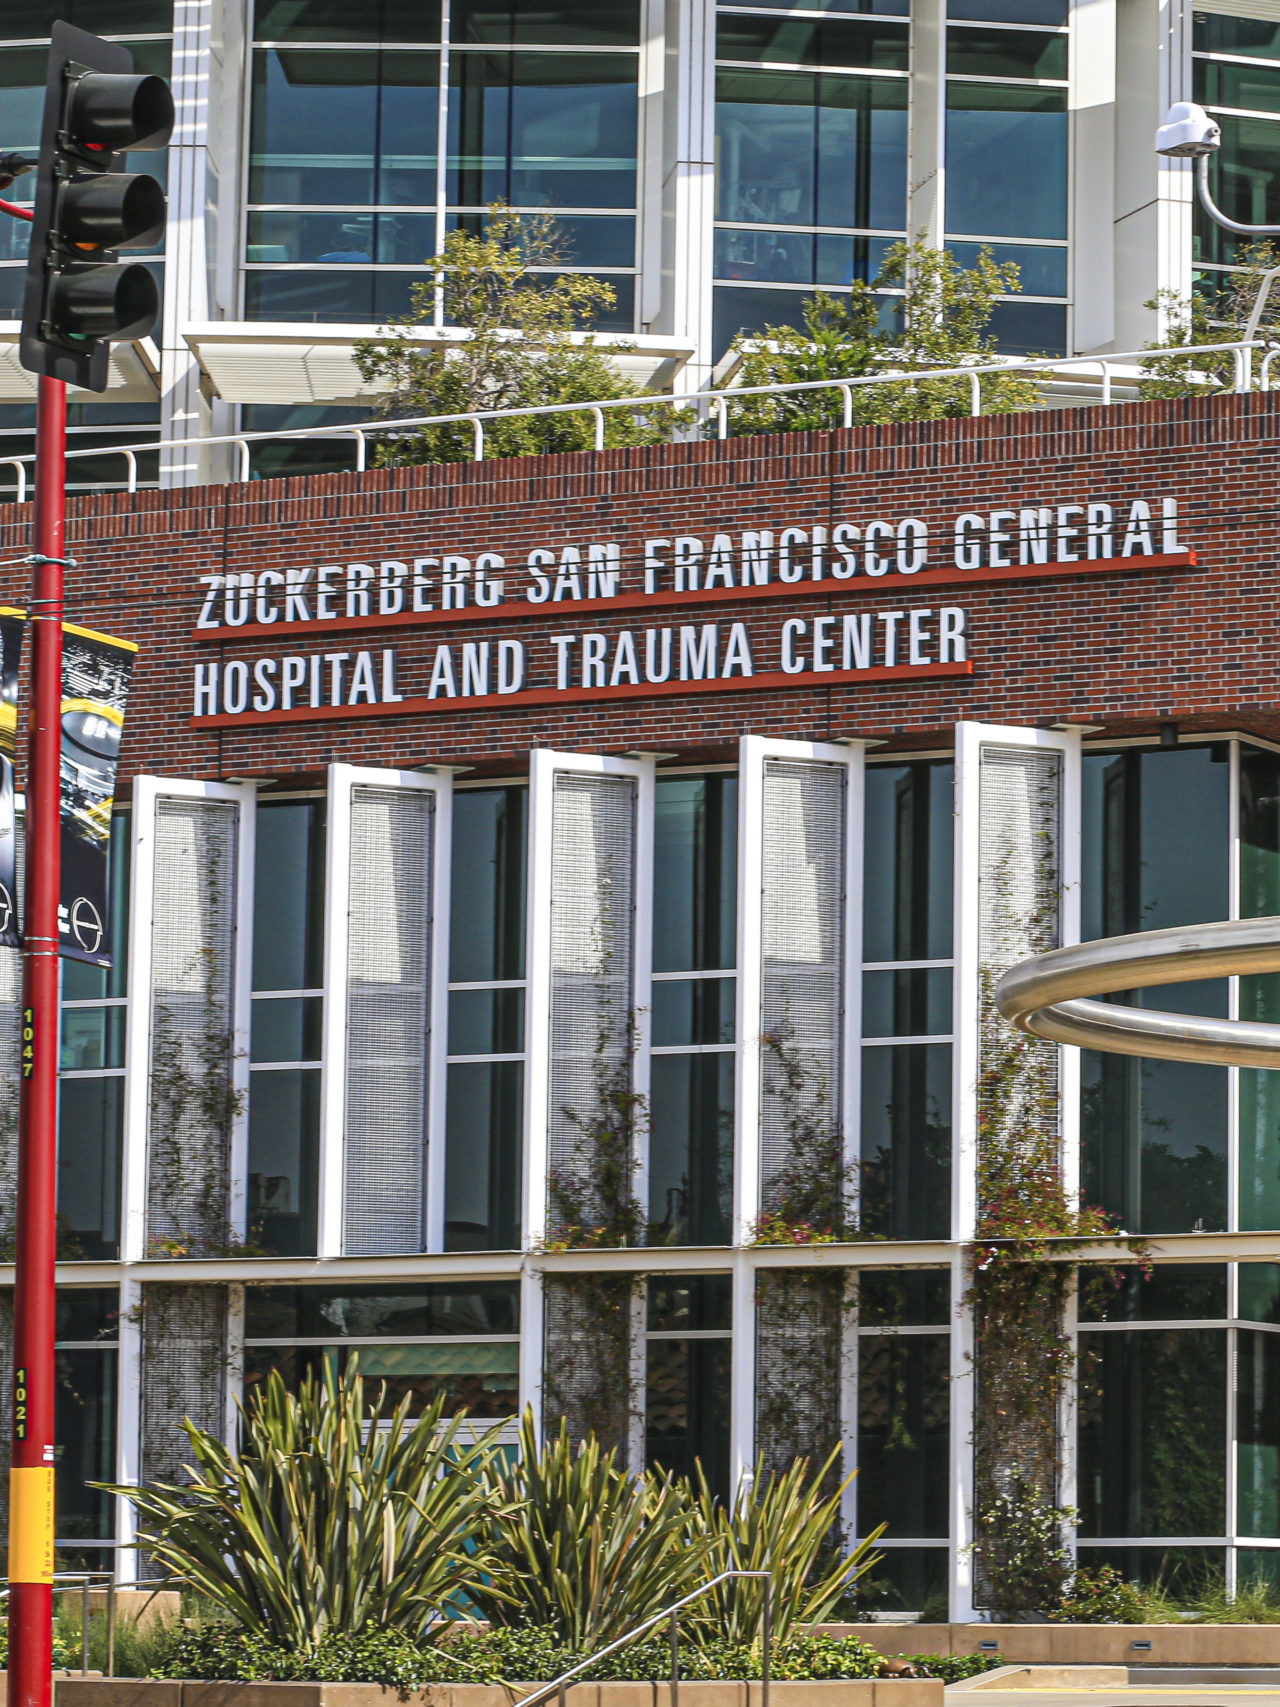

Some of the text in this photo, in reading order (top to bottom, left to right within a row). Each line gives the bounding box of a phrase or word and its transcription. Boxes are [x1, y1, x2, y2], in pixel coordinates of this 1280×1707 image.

[197, 497, 1190, 630] ZUCKERBERG SAN FRANCISCO GENERAL
[193, 606, 969, 717] HOSPITAL AND TRAUMA CENTER
[23, 1009, 34, 1077] 1047
[16, 1369, 27, 1438] 1021
